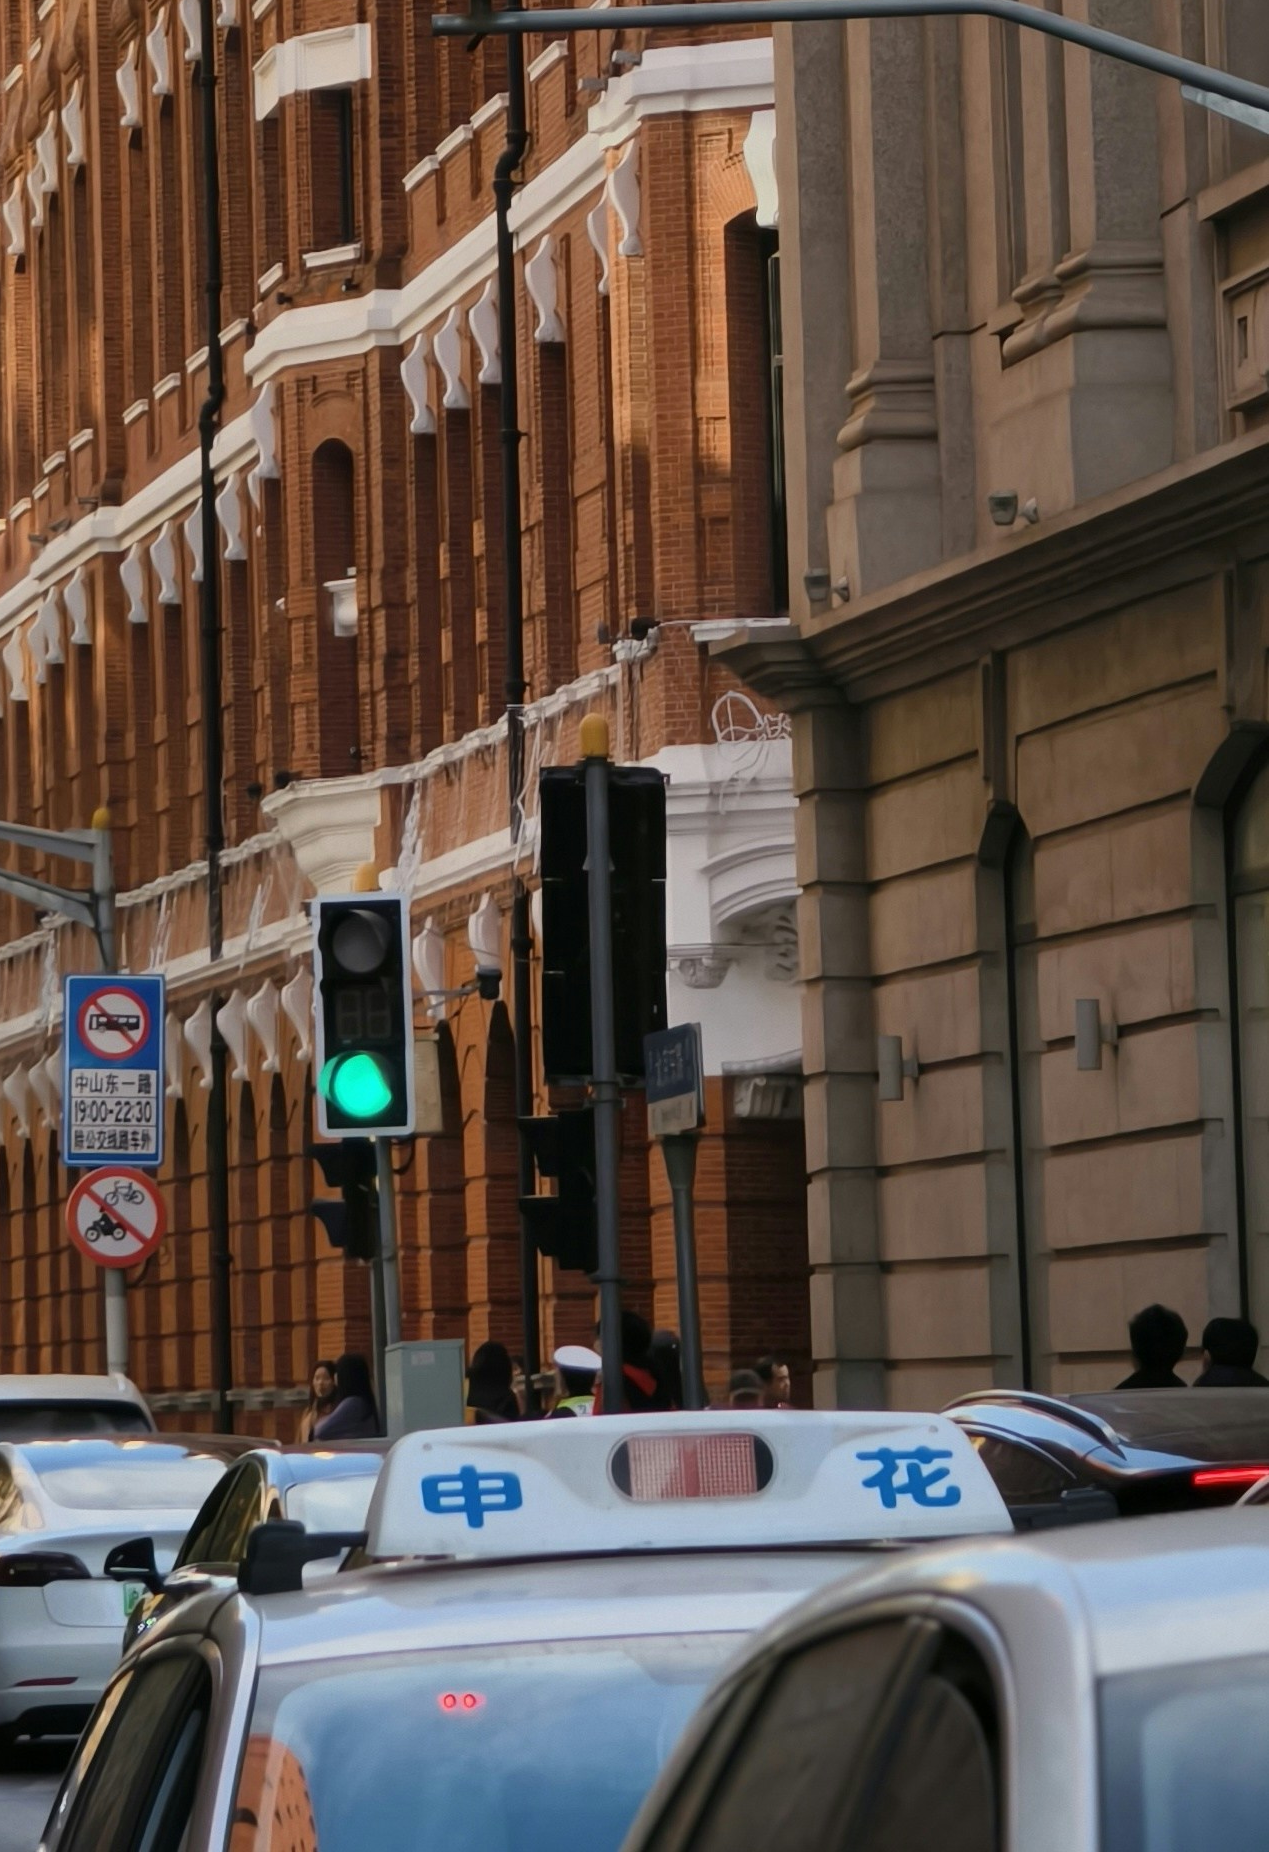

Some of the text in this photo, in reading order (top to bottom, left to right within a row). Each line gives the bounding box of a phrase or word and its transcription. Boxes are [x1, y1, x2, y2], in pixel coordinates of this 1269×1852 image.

[74, 1072, 152, 1094] 中山东一路
[74, 1099, 153, 1123] 19:00-22:30
[74, 1129, 152, 1151] 除公交线路车外
[421, 1446, 962, 1529] 申 花
